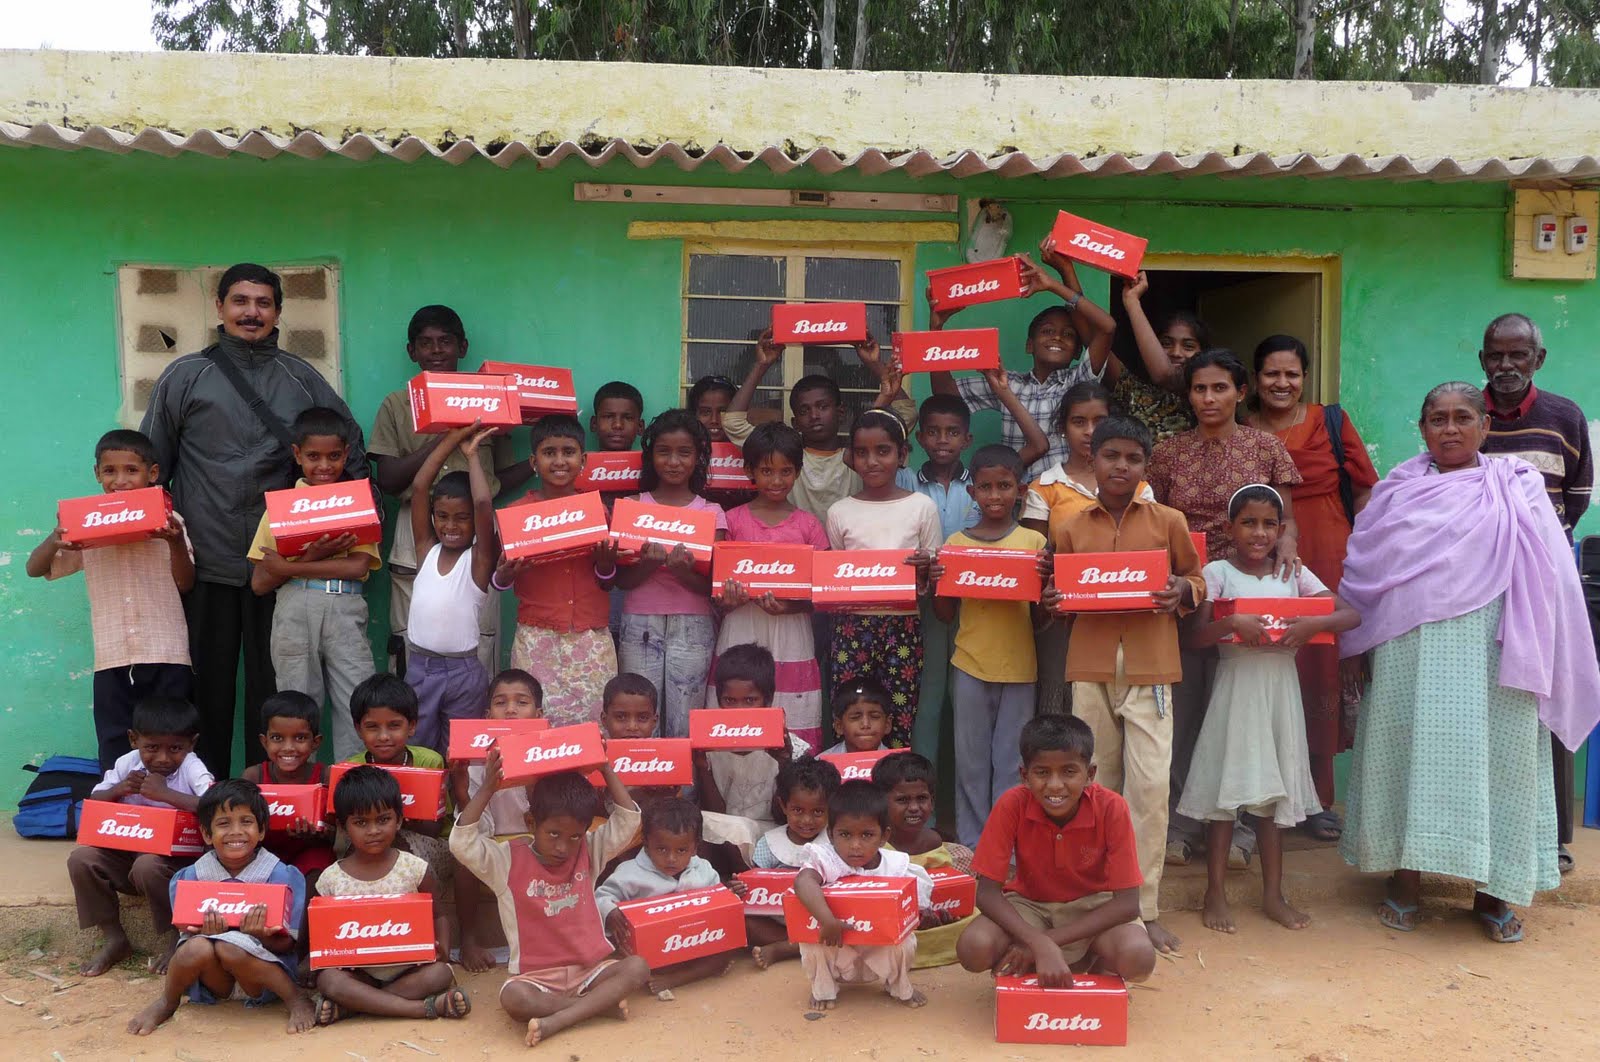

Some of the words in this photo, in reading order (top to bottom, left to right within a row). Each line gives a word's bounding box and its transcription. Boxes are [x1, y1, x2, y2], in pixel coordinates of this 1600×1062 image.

[1069, 233, 1125, 260] Bata
[948, 279, 1000, 298] Bata
[792, 320, 848, 334] Bata
[922, 345, 980, 361] Bata
[445, 396, 501, 412] Bata
[709, 454, 745, 468] ata
[589, 466, 641, 481] Bata
[288, 491, 355, 514] Bata
[81, 508, 146, 528] Bata
[522, 509, 586, 532] Bata
[632, 514, 696, 535] Bata
[733, 558, 796, 575] Bata
[833, 562, 897, 578] Bata
[1077, 566, 1149, 584] Bata
[955, 571, 1019, 588] Bata
[708, 723, 763, 737] Bata
[524, 742, 583, 763] Bata
[613, 756, 675, 773] Bata
[841, 765, 871, 780] Ba
[268, 800, 296, 816] ta
[97, 818, 154, 839] Bata
[645, 896, 711, 914] Bata
[746, 887, 783, 906] Ba
[335, 919, 412, 940] Bata
[661, 928, 726, 953] Bata
[1024, 1012, 1102, 1031] Bata
